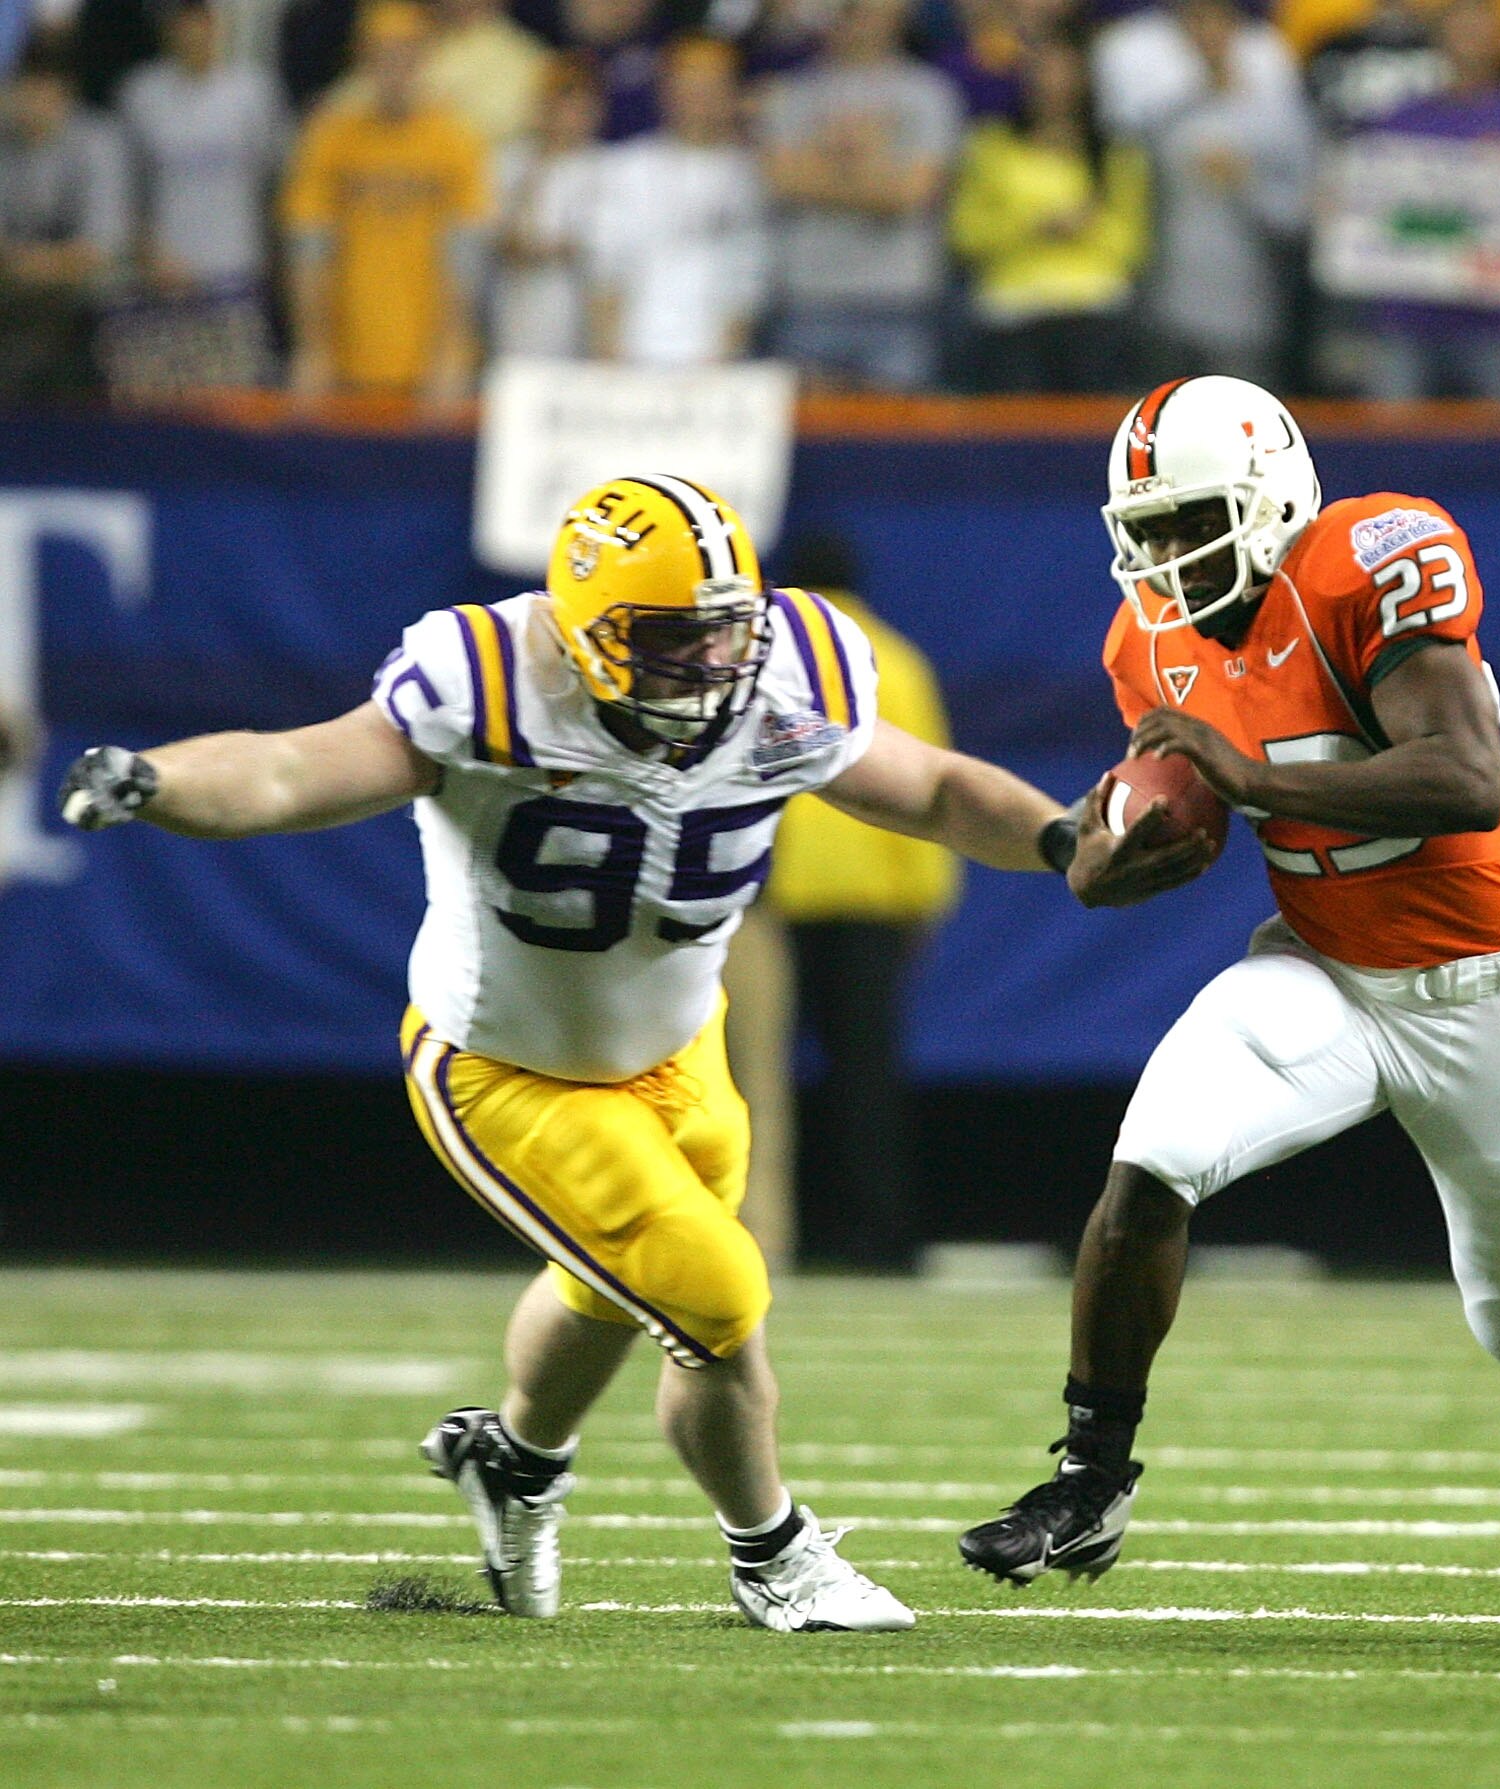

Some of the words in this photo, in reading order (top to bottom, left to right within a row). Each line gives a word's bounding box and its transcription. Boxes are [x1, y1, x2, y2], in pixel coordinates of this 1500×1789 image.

[1129, 479, 1153, 497] ACC
[562, 491, 657, 550] SU
[1361, 531, 1410, 566] PEACH
[1373, 543, 1468, 638] 23
[494, 796, 791, 952] 95
